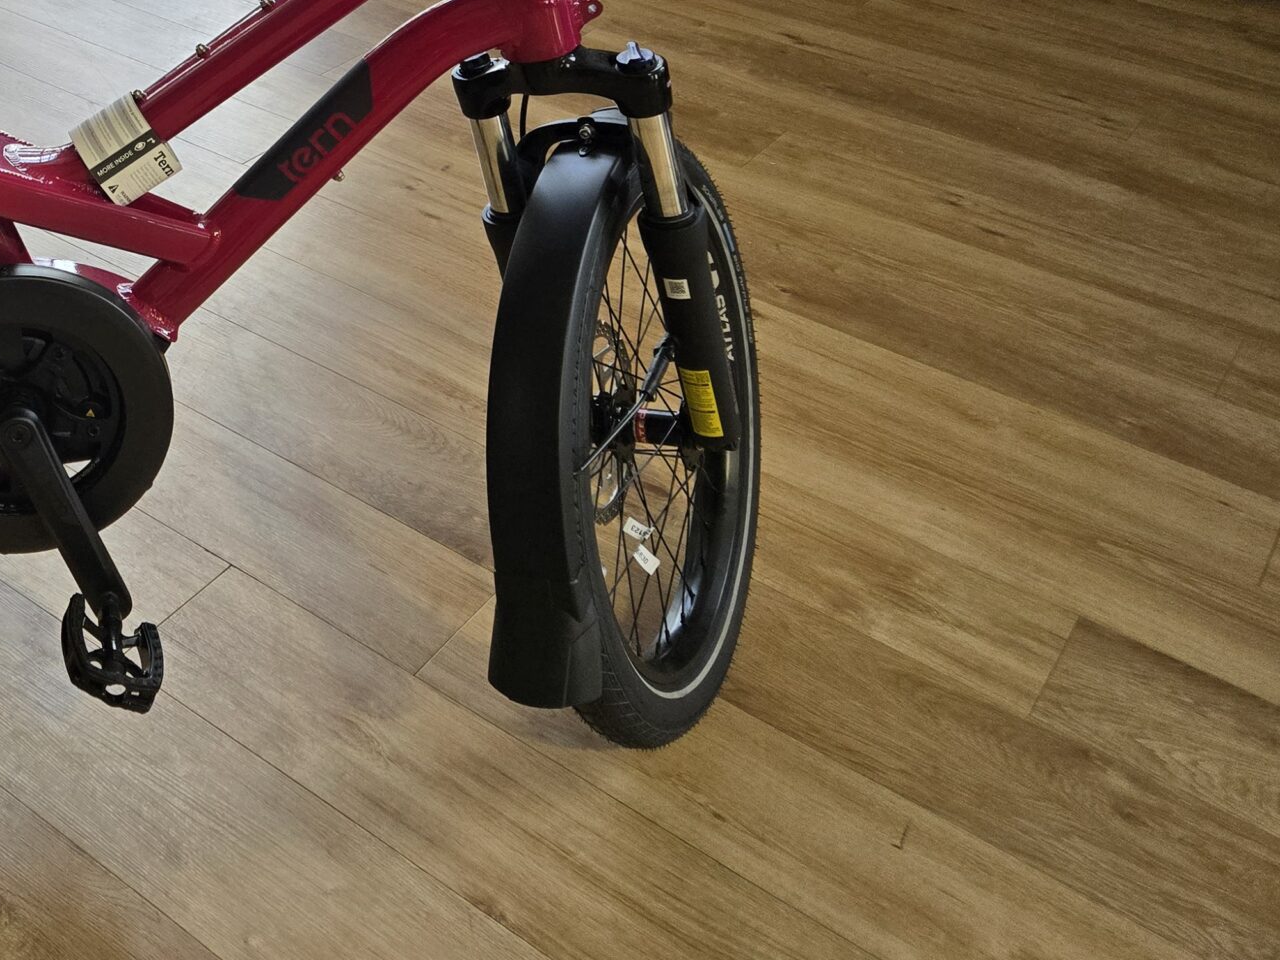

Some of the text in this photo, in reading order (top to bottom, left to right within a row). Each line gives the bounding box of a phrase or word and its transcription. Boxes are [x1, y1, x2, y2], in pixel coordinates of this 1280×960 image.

[97, 150, 134, 177] MORE INSIDE
[153, 150, 175, 177] Tern
[277, 111, 358, 183] tern
[715, 293, 735, 362] ATLAS
